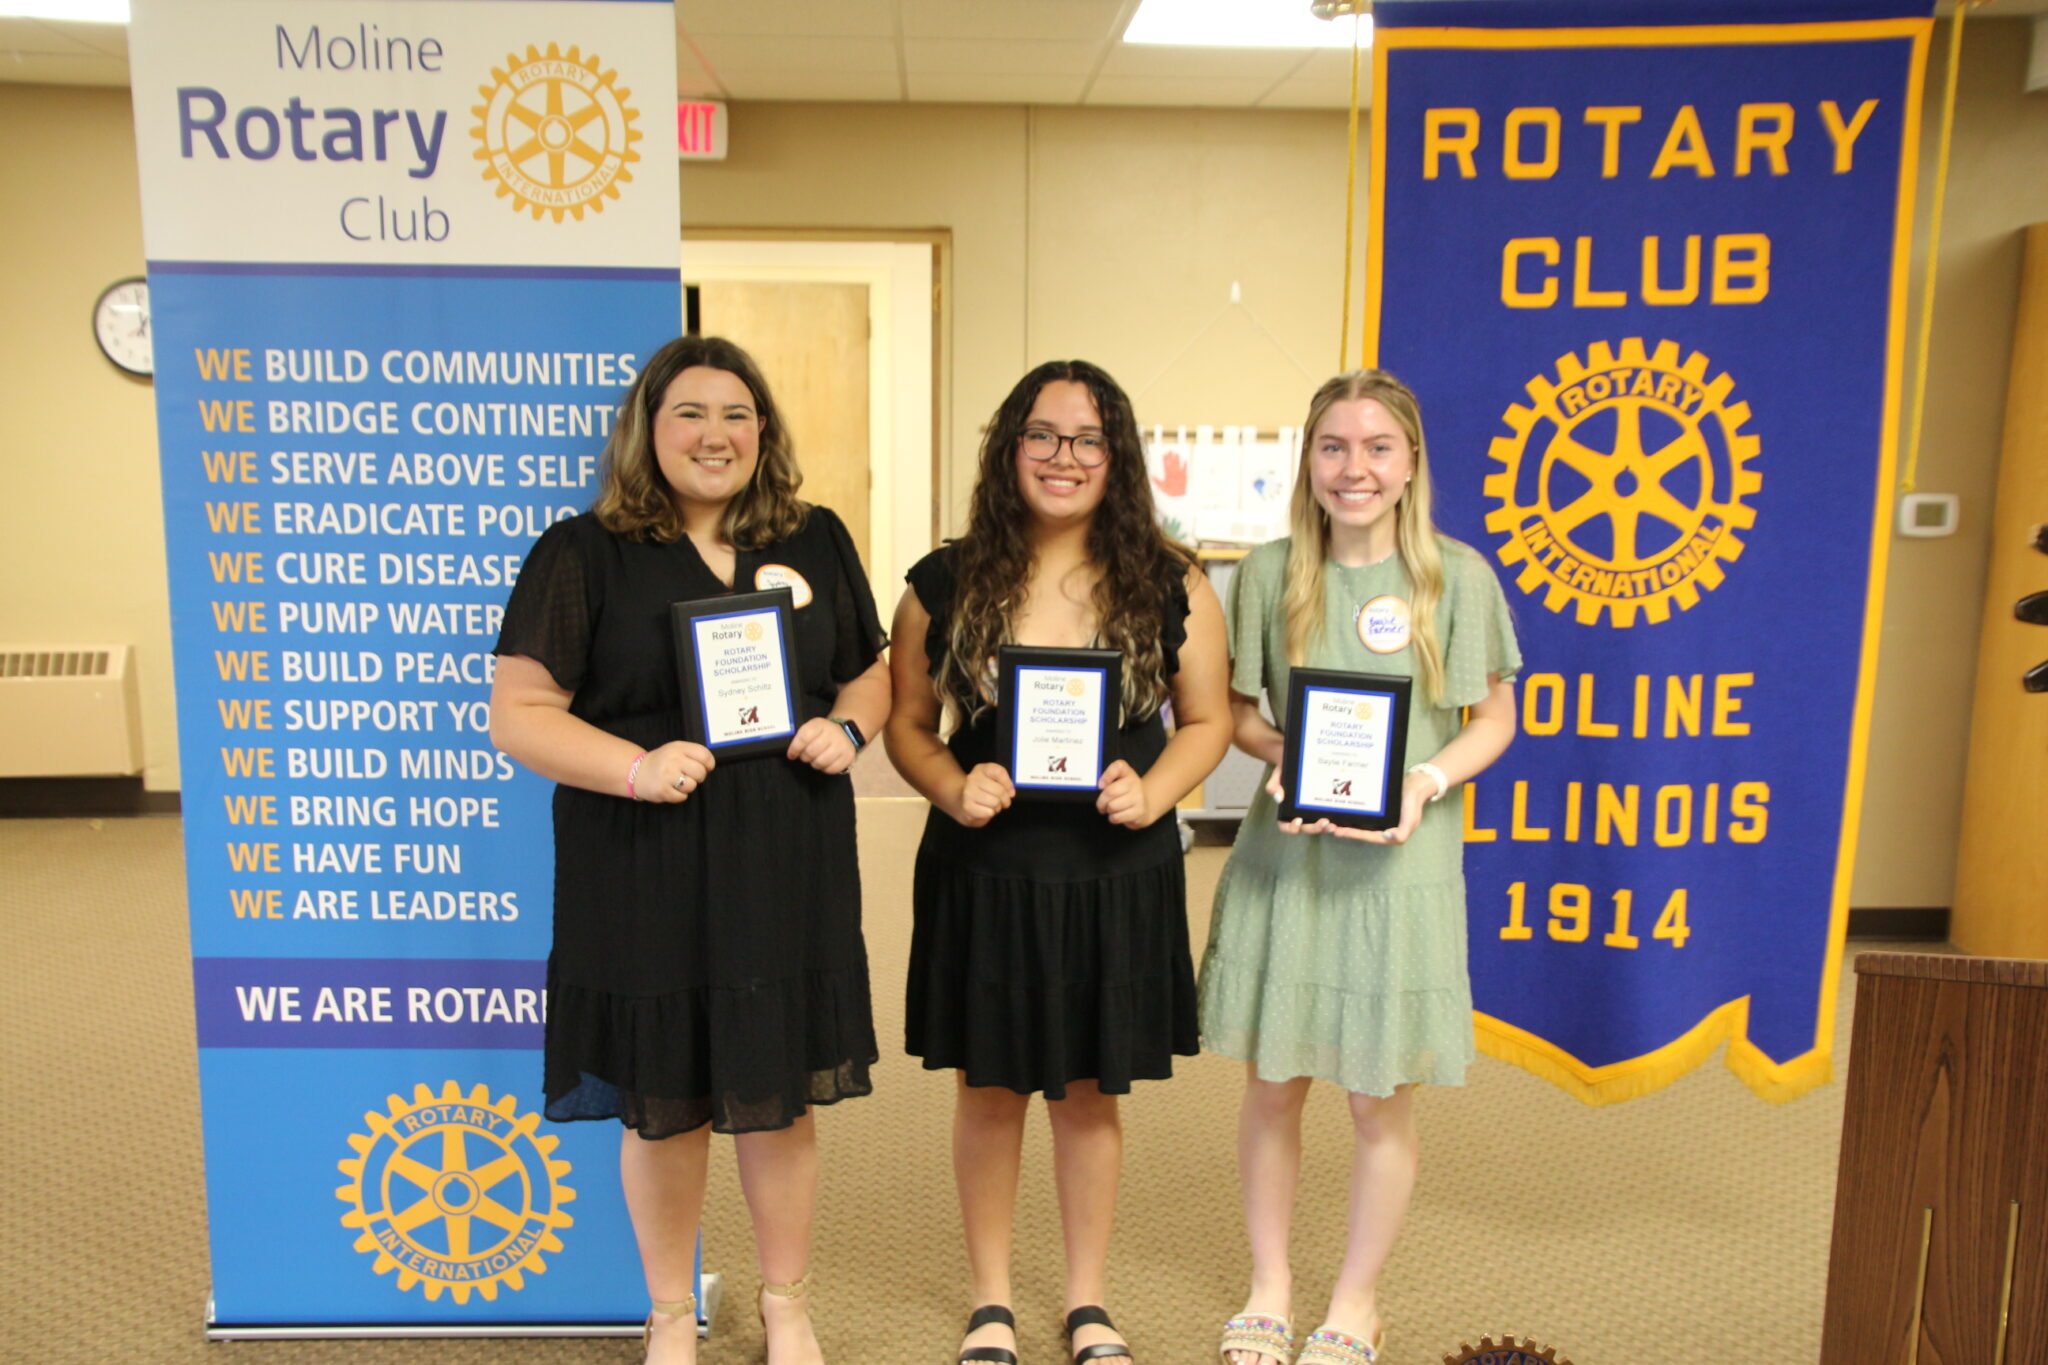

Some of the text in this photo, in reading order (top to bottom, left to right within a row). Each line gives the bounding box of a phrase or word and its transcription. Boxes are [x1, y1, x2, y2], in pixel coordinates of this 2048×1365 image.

[276, 22, 443, 72] Moline
[518, 62, 588, 83] ROTARY
[177, 87, 447, 179] Rotary
[678, 103, 716, 153] XIT
[1424, 99, 1879, 179] ROTARY
[499, 161, 617, 204] INTERNATIONAL
[340, 197, 450, 242] Club
[1501, 233, 1771, 308] CLUB
[195, 348, 638, 387] WE BUILD COMMUNITIES
[1560, 368, 1702, 417] ROTARY
[198, 400, 622, 437] WE BRIDGE CONTINENT
[202, 451, 595, 487] WE SERVE ABOVE SELF
[205, 502, 261, 533] WE
[274, 502, 465, 535] ERADICATE
[208, 552, 521, 586] WE CURE DISEASE
[1521, 520, 1723, 598] INTERNATIONAL
[212, 601, 505, 635] WE PUMP WATER
[711, 629, 742, 641] Rotary
[724, 645, 757, 656] ROTARY
[215, 651, 270, 681] WE
[282, 651, 382, 682] BUILD
[713, 662, 772, 677] SCHOLARSHIP
[715, 653, 768, 667] FOUNDATION
[1034, 681, 1064, 692] Rotary
[1043, 699, 1076, 707] ROTARY
[218, 699, 491, 732] WE SUPPORT YO
[1033, 707, 1086, 716] FOUNDATION
[1323, 702, 1352, 715] Rotary
[1523, 672, 1755, 738] OLINE
[1320, 729, 1373, 740] FOUNDATION
[1331, 721, 1364, 731] ROTARY
[221, 748, 515, 780] WE BUILD MINDS
[224, 795, 500, 828] WE BRING HOPE
[1463, 781, 1771, 847] LLINOIS
[227, 843, 461, 873] WE HAVE FUN
[230, 890, 519, 921] WE ARE LEADERS
[1500, 882, 1691, 950] 1914
[236, 987, 302, 1022] WE
[312, 987, 393, 1022] ARE
[403, 1105, 503, 1133] ROTARY
[377, 1227, 542, 1281] INTERNATIONAL
